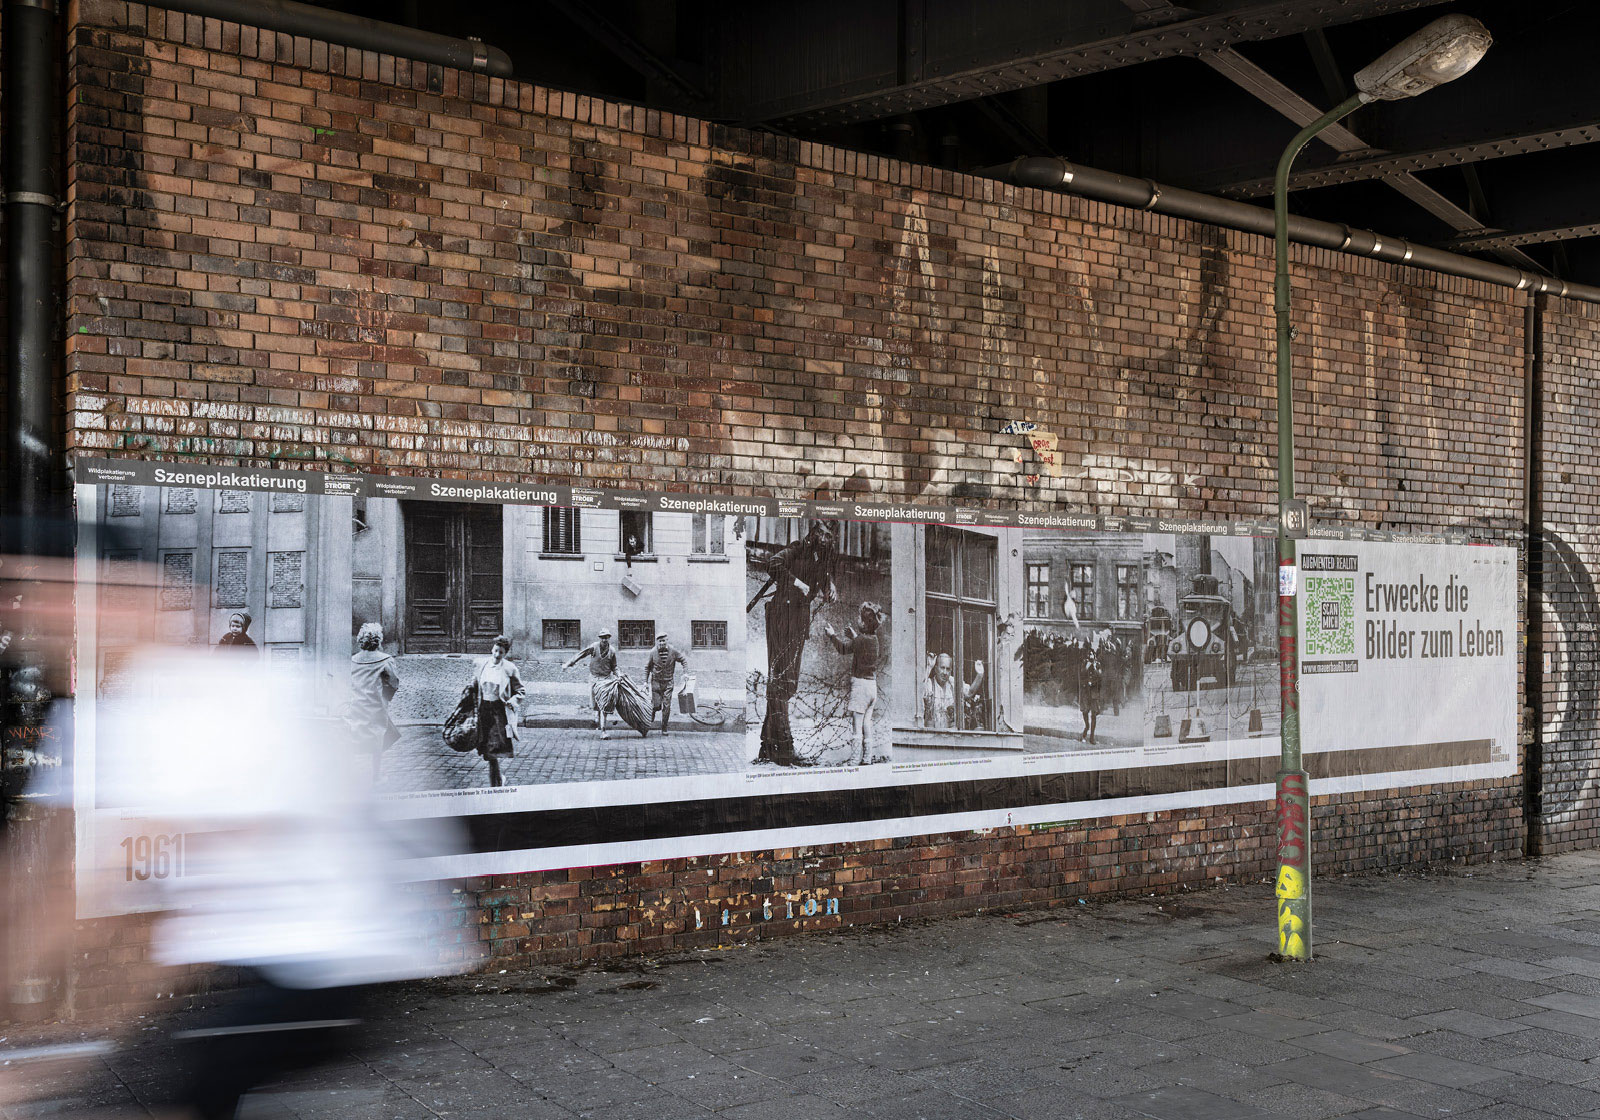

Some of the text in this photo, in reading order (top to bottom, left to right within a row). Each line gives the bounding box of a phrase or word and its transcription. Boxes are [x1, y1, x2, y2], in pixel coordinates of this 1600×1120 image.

[88, 468, 136, 477] Wildplakatierung
[154, 468, 307, 493] Szeneplakatierung
[324, 482, 351, 490] STRÖER
[375, 483, 416, 491] Wildplakatierung
[430, 483, 557, 504] Szeneplakatierung
[660, 497, 767, 516] Szeneplakatierung
[854, 505, 946, 522] Szeneplakatierung
[1018, 514, 1096, 529] Szeneplakatierung
[1158, 521, 1228, 535] Szeneplakatierung
[1302, 556, 1358, 570] AUGMENTED REALITY
[1365, 572, 1469, 613] Erwecke die
[1322, 603, 1338, 615] SCAN
[1322, 615, 1338, 628] MICH
[1365, 619, 1504, 660] Bilder zum Leben
[120, 834, 182, 881] 1961
